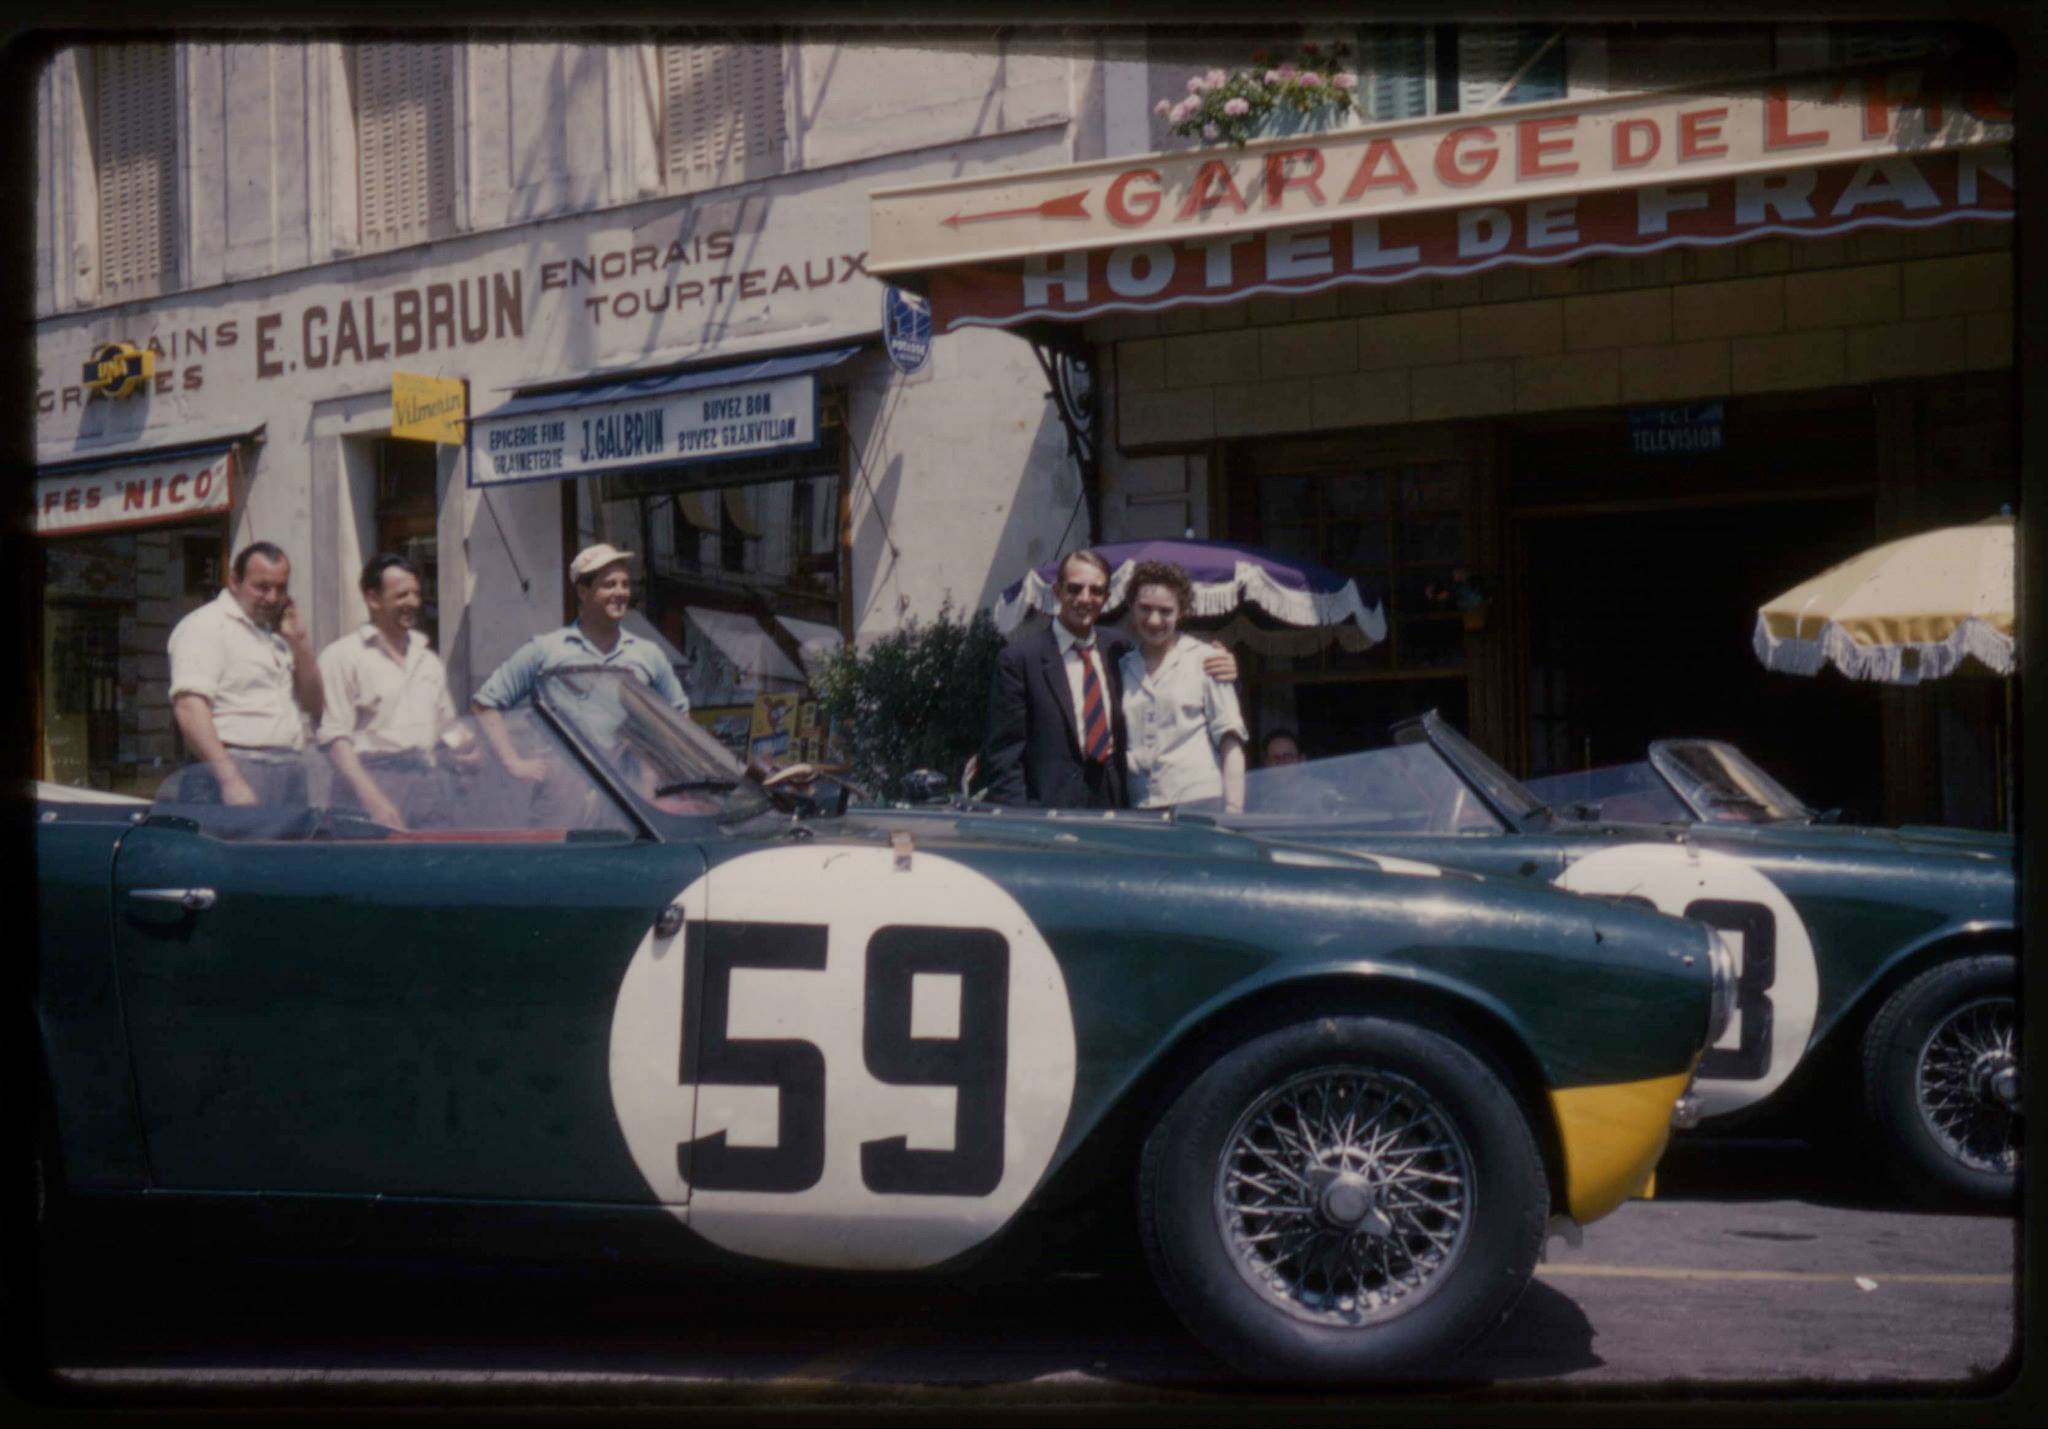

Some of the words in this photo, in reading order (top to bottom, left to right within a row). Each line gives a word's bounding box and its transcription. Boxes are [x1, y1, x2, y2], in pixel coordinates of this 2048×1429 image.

[1104, 114, 1579, 227] GARAGE
[1613, 107, 1729, 171] DE
[540, 231, 735, 292] ENGRAIS
[585, 250, 871, 325] TOURTEAUX
[1022, 218, 1421, 308] HOTEL
[1457, 201, 1580, 258] DE
[676, 920, 1010, 1197] 59
